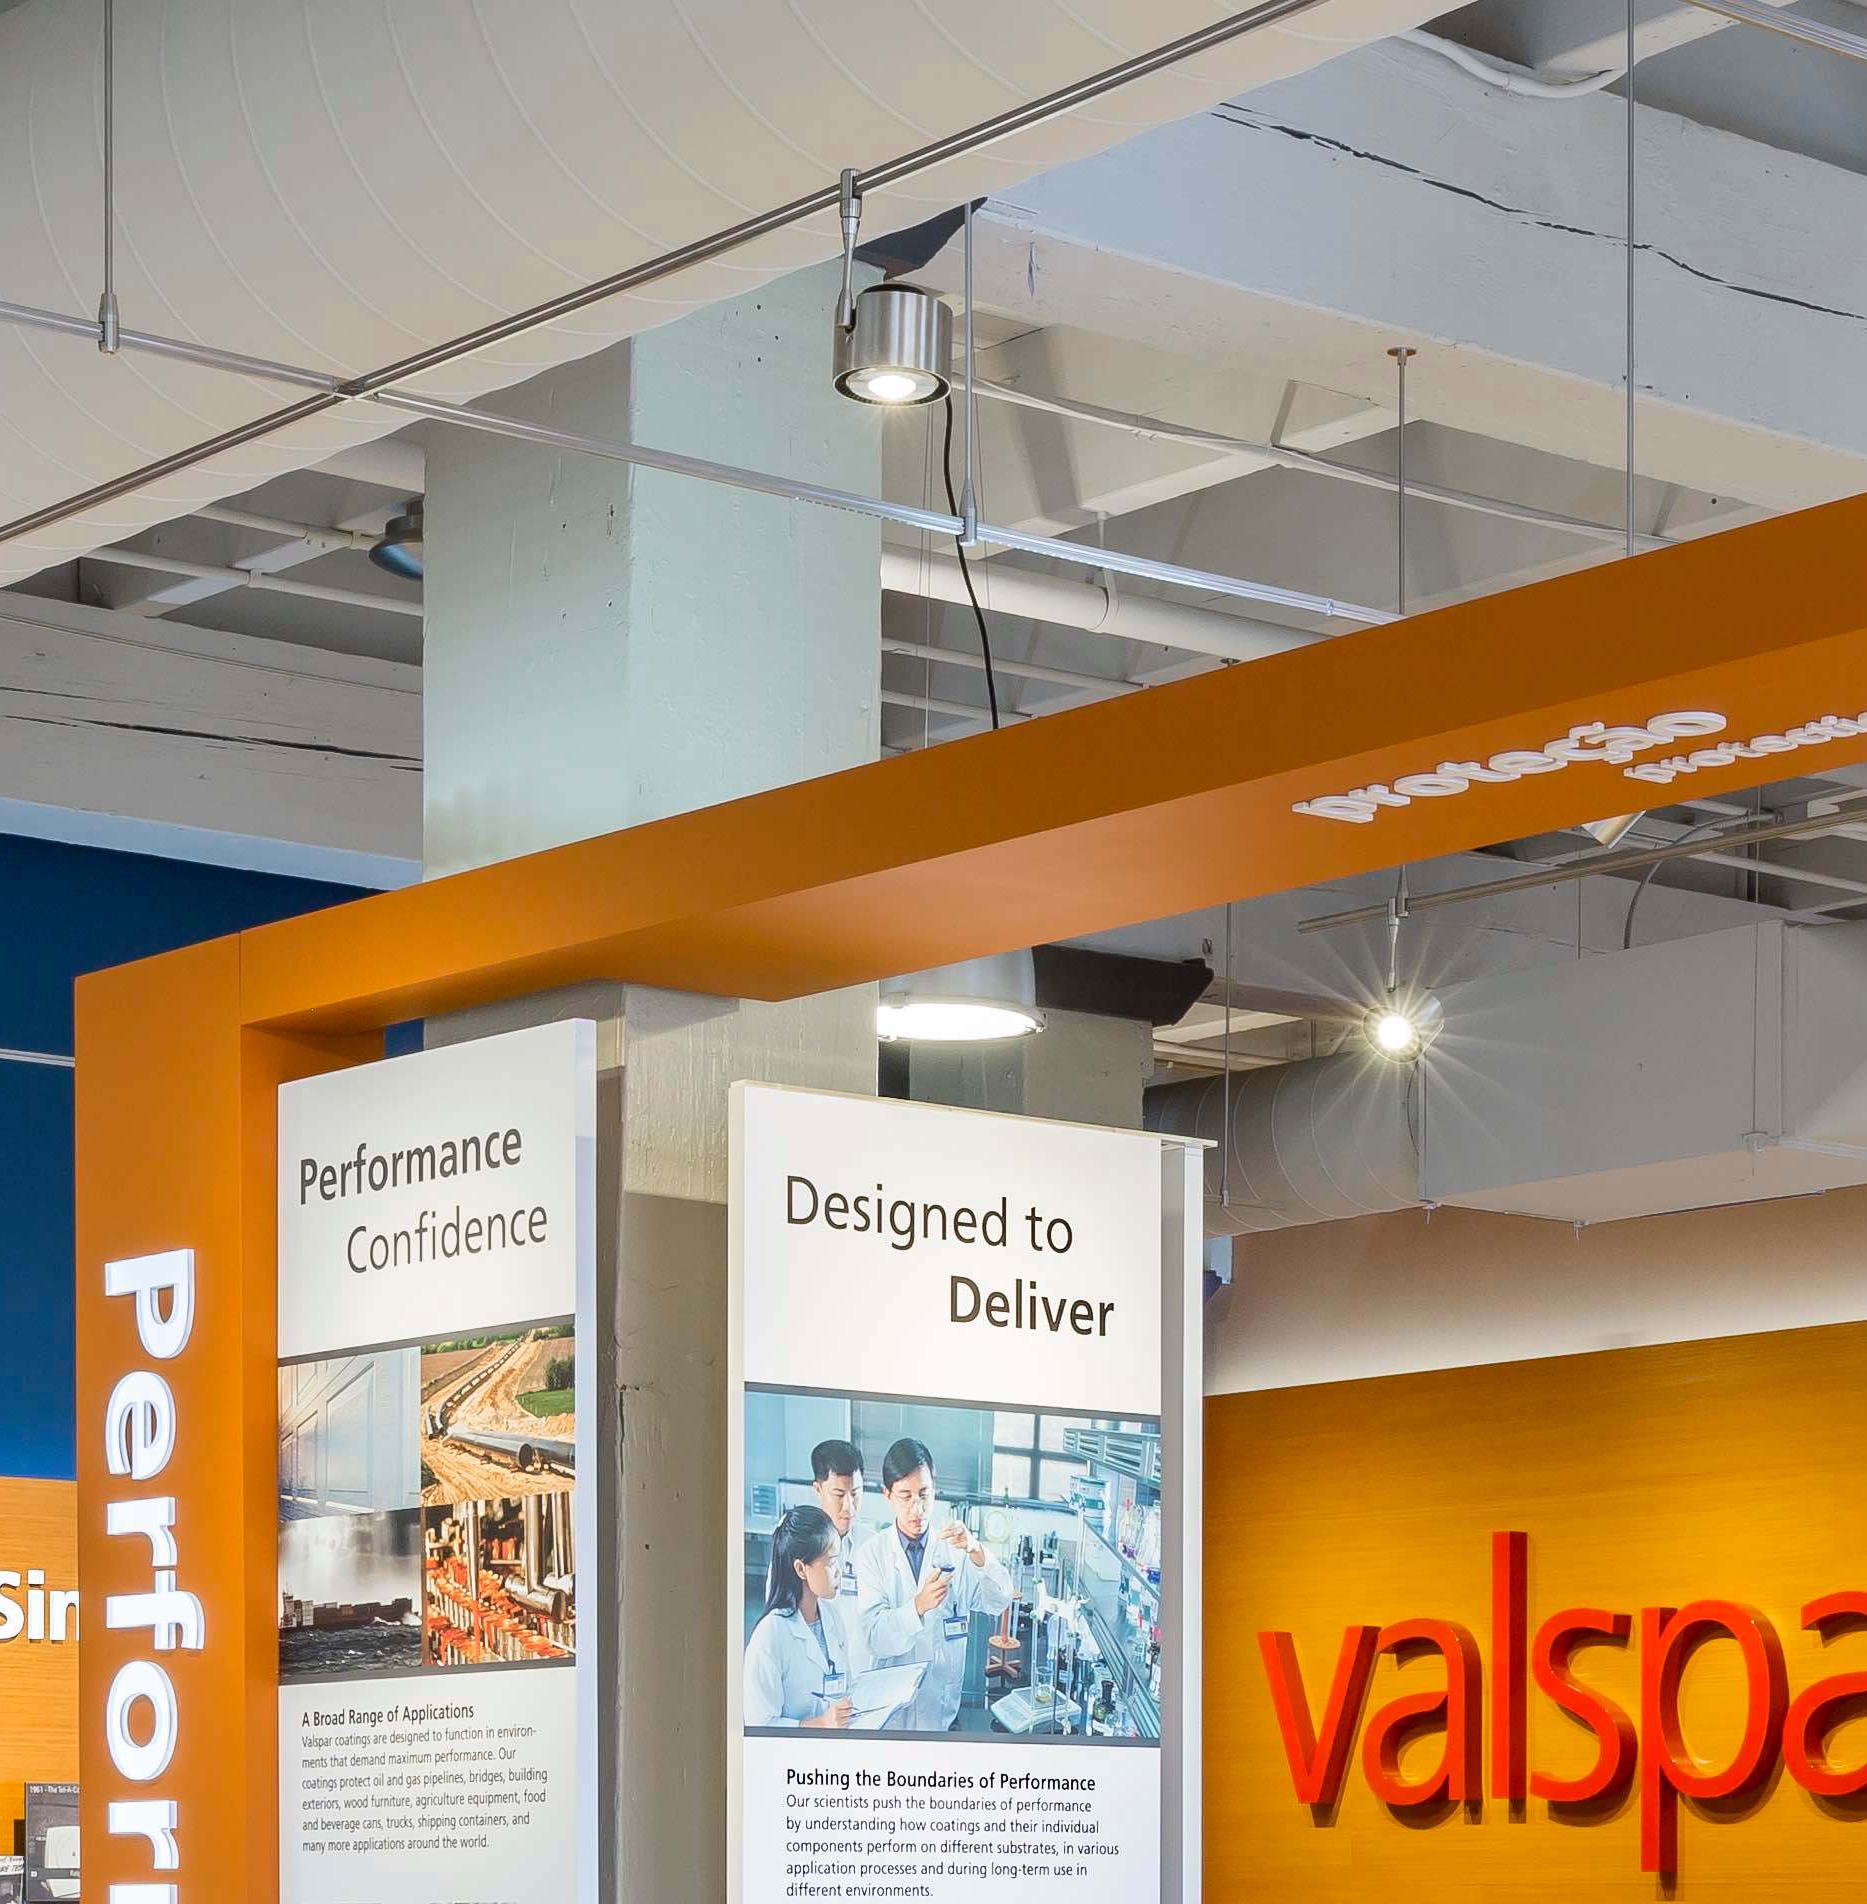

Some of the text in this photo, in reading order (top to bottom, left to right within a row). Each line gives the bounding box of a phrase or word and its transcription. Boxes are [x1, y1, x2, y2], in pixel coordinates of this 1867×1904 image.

[300, 1128, 522, 1205] Performance
[787, 1175, 1073, 1254] Designed to
[348, 1205, 547, 1273] Confidence
[950, 1275, 1114, 1336] Deliver
[301, 1702, 475, 1728] A Broad Range of Applications
[786, 1768, 1096, 1791] Pushing the Boundaries of Performance
[786, 1793, 1092, 1815] Our scientists push the boundaries of performance
[786, 1816, 1099, 1836] by understanding how coatings and their individual
[785, 1839, 1120, 1857] components perform on different substrates, in various
[786, 1860, 1088, 1880] application processes and during long-term use in
[786, 1882, 934, 1897] different environments.
